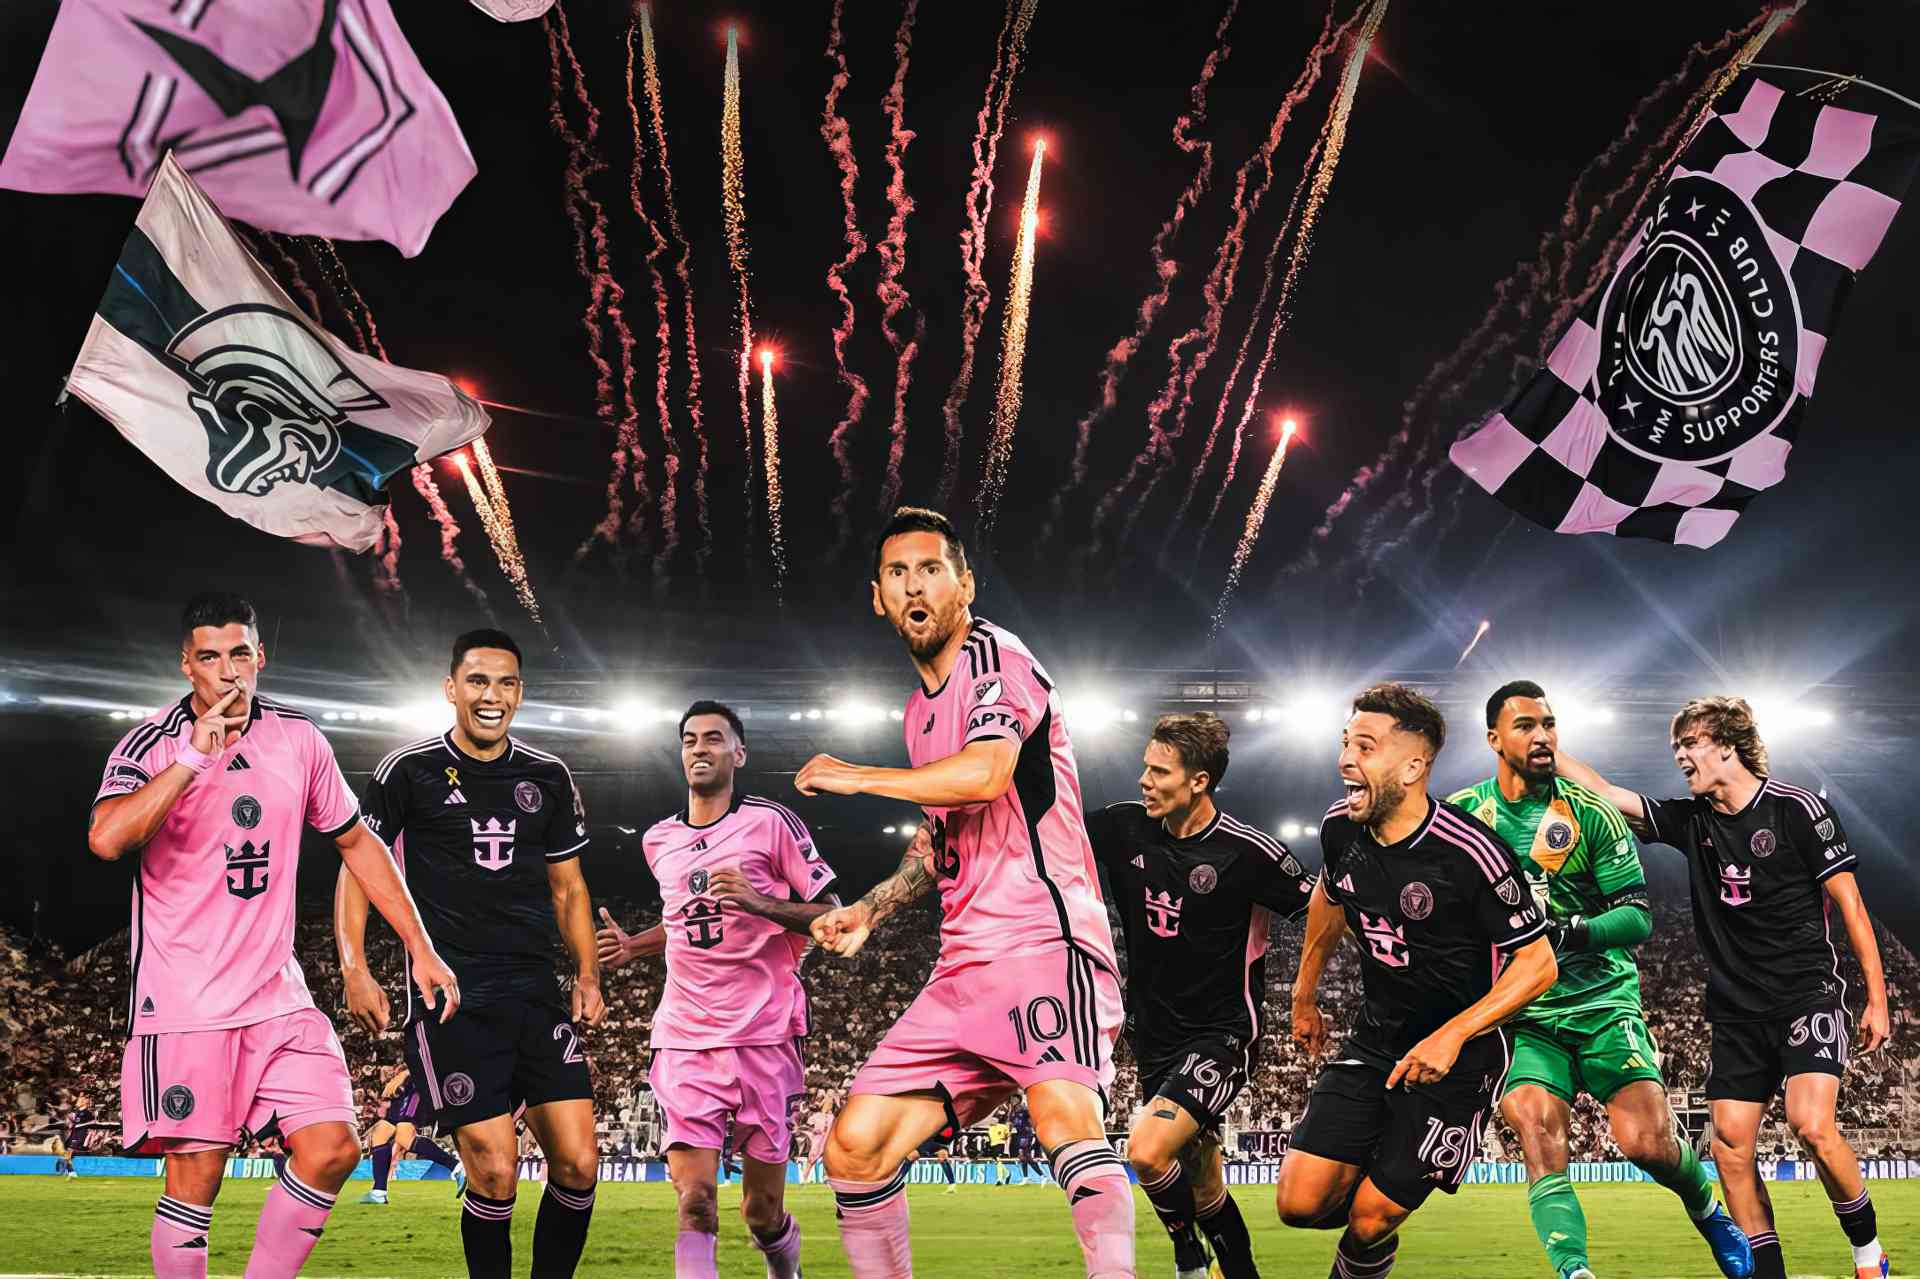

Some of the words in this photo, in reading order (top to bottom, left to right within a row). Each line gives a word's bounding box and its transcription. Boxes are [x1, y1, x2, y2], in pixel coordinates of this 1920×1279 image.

[1728, 236, 1774, 318] CLUB
[1682, 331, 1779, 444] SUPPORTERS
[1647, 408, 1673, 444] MM
[553, 1022, 584, 1064] 2
[1007, 995, 1068, 1055] 10
[1787, 1012, 1837, 1047] 30
[1178, 1052, 1221, 1088] 16
[1417, 1116, 1468, 1168] 18
